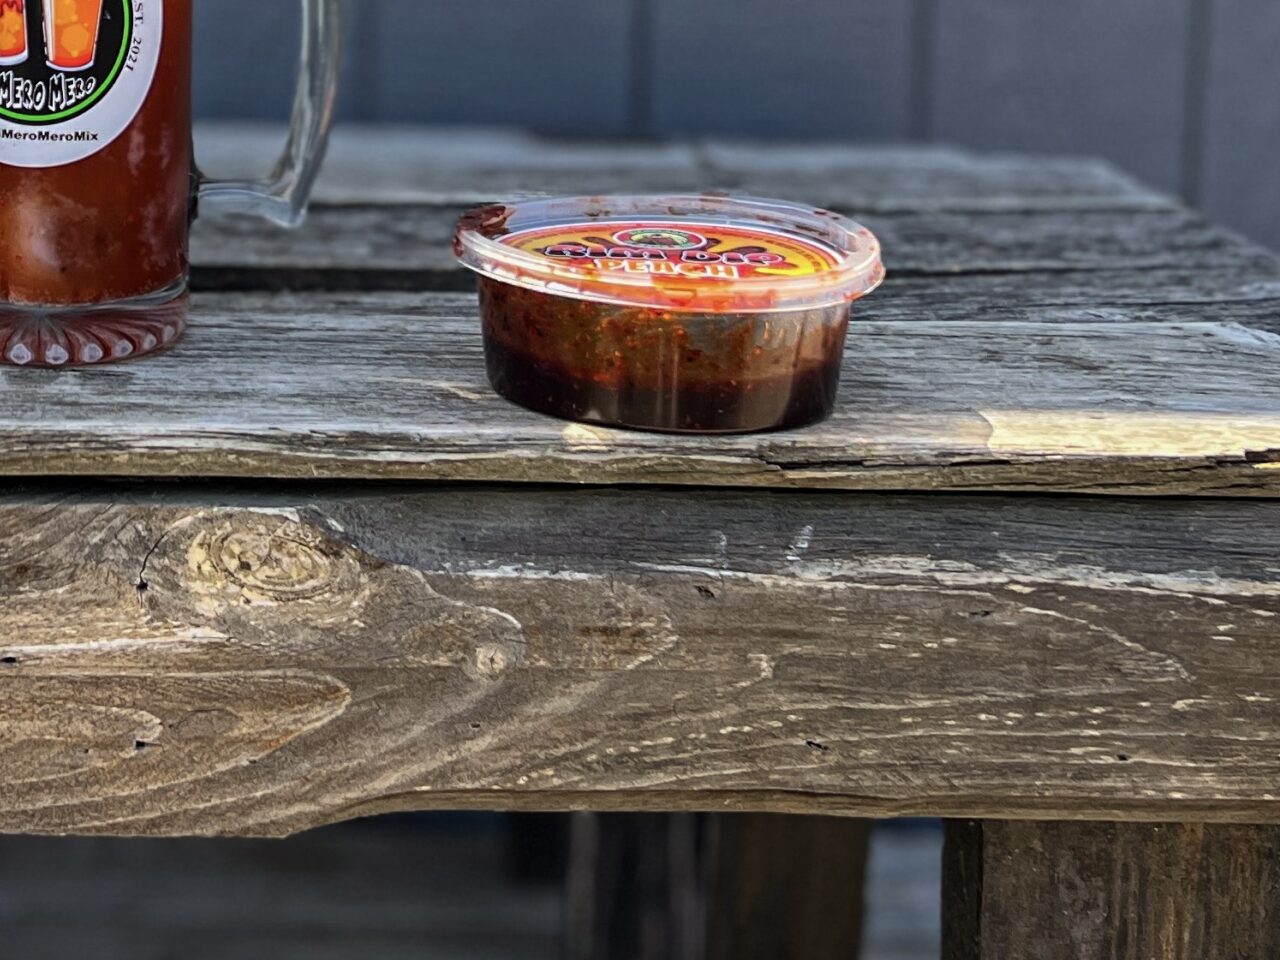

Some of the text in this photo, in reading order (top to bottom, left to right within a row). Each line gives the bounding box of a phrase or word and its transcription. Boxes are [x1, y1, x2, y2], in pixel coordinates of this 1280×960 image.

[124, 36, 143, 72] 2021
[543, 243, 669, 263] RIM
[680, 250, 784, 266] DIP
[594, 258, 740, 280] PEACH
